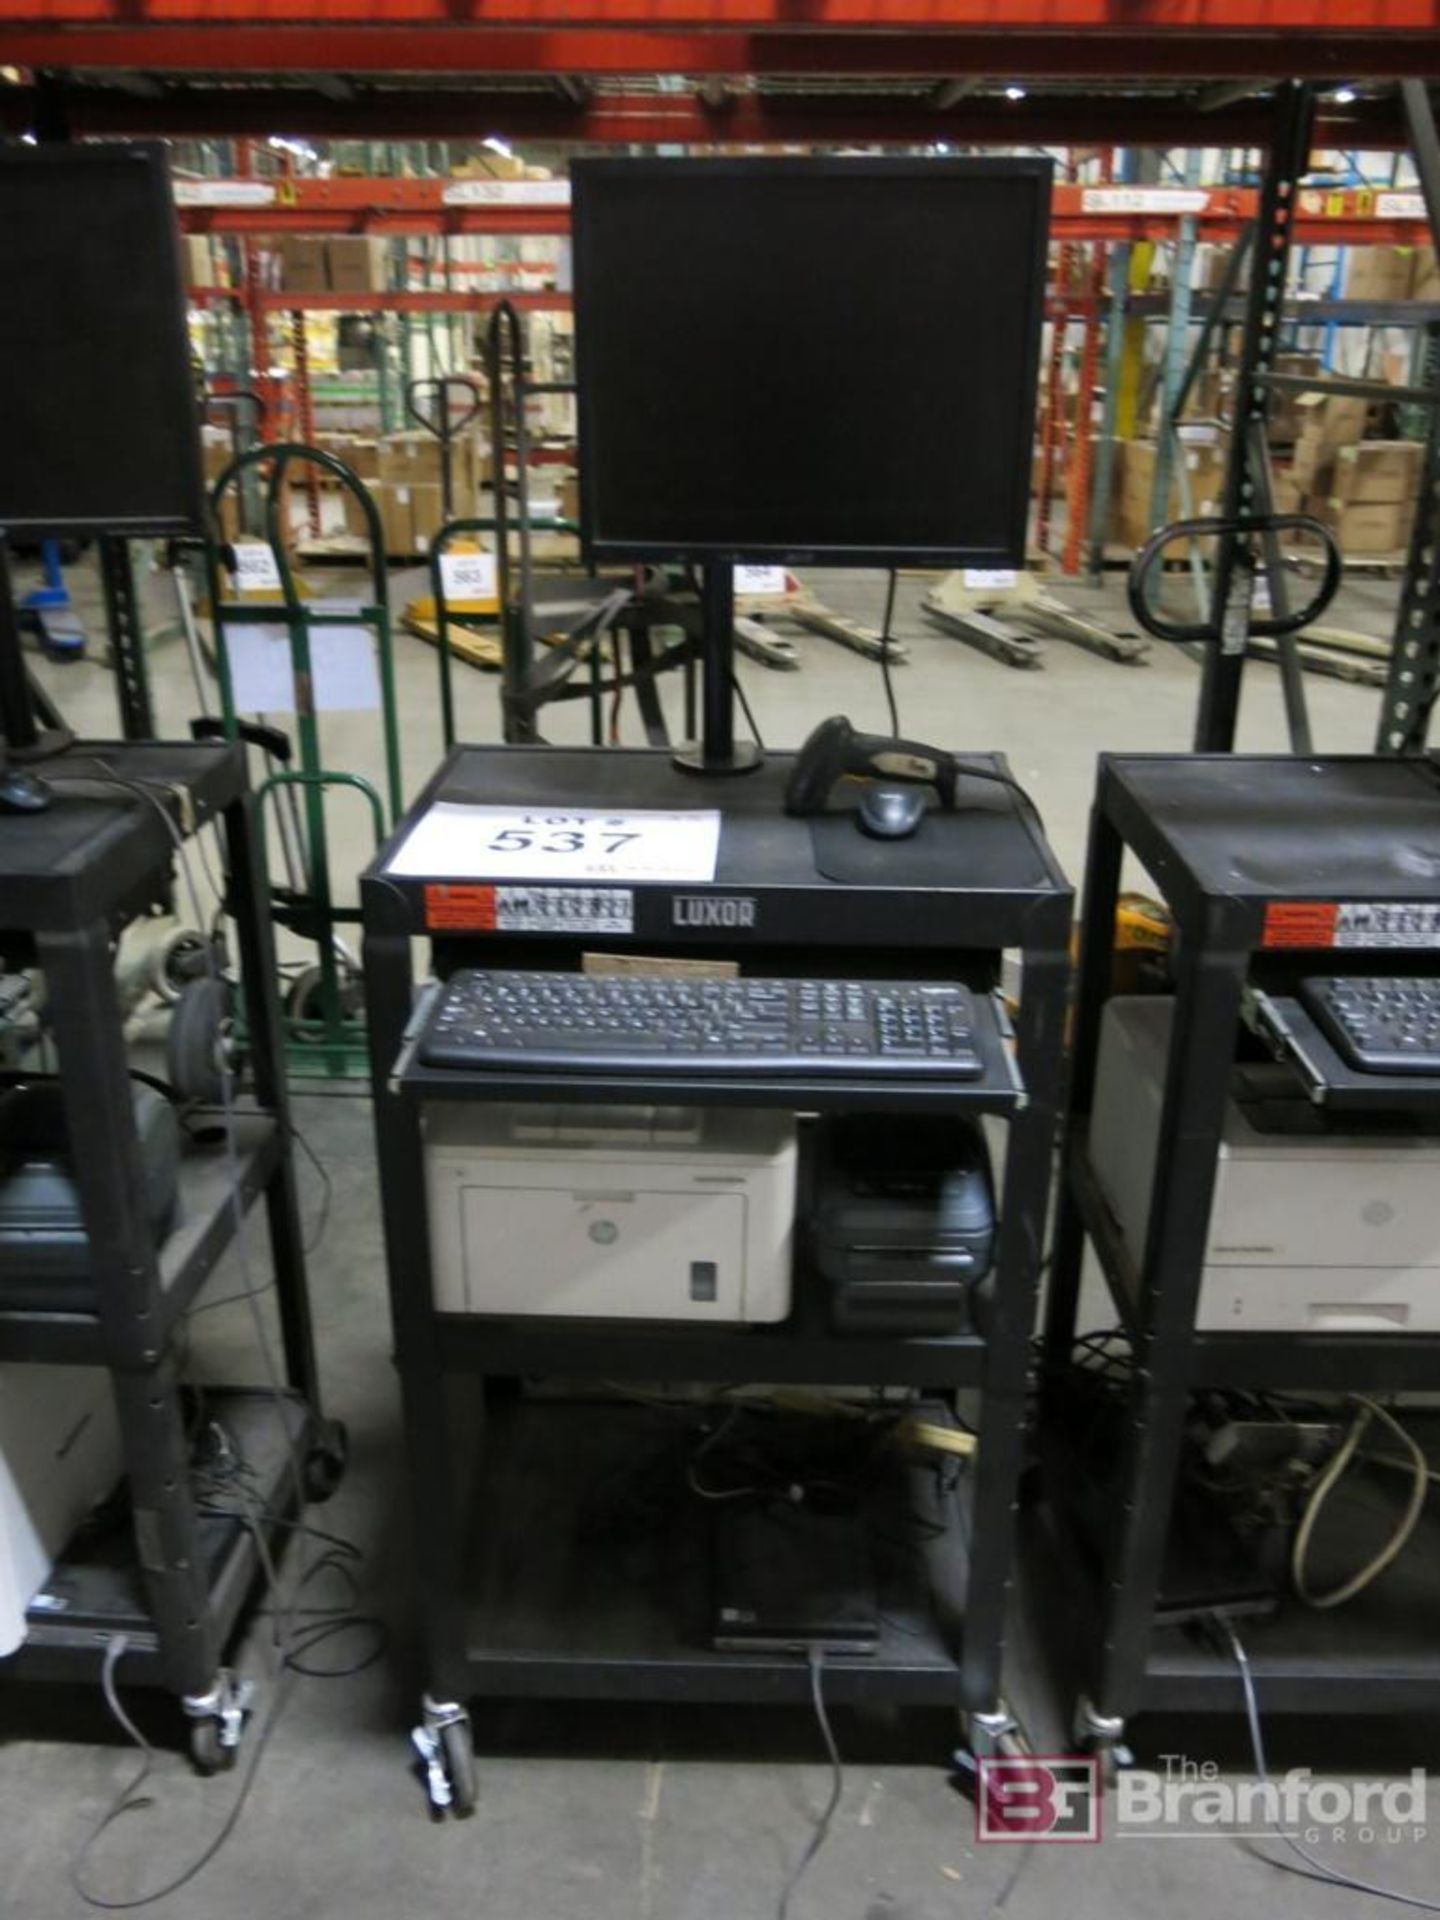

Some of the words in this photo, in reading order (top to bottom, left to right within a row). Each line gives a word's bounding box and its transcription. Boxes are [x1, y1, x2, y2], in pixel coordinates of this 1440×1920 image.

[523, 815, 590, 825] LOT
[487, 830, 642, 853] 537
[672, 898, 756, 927] LUXOR
